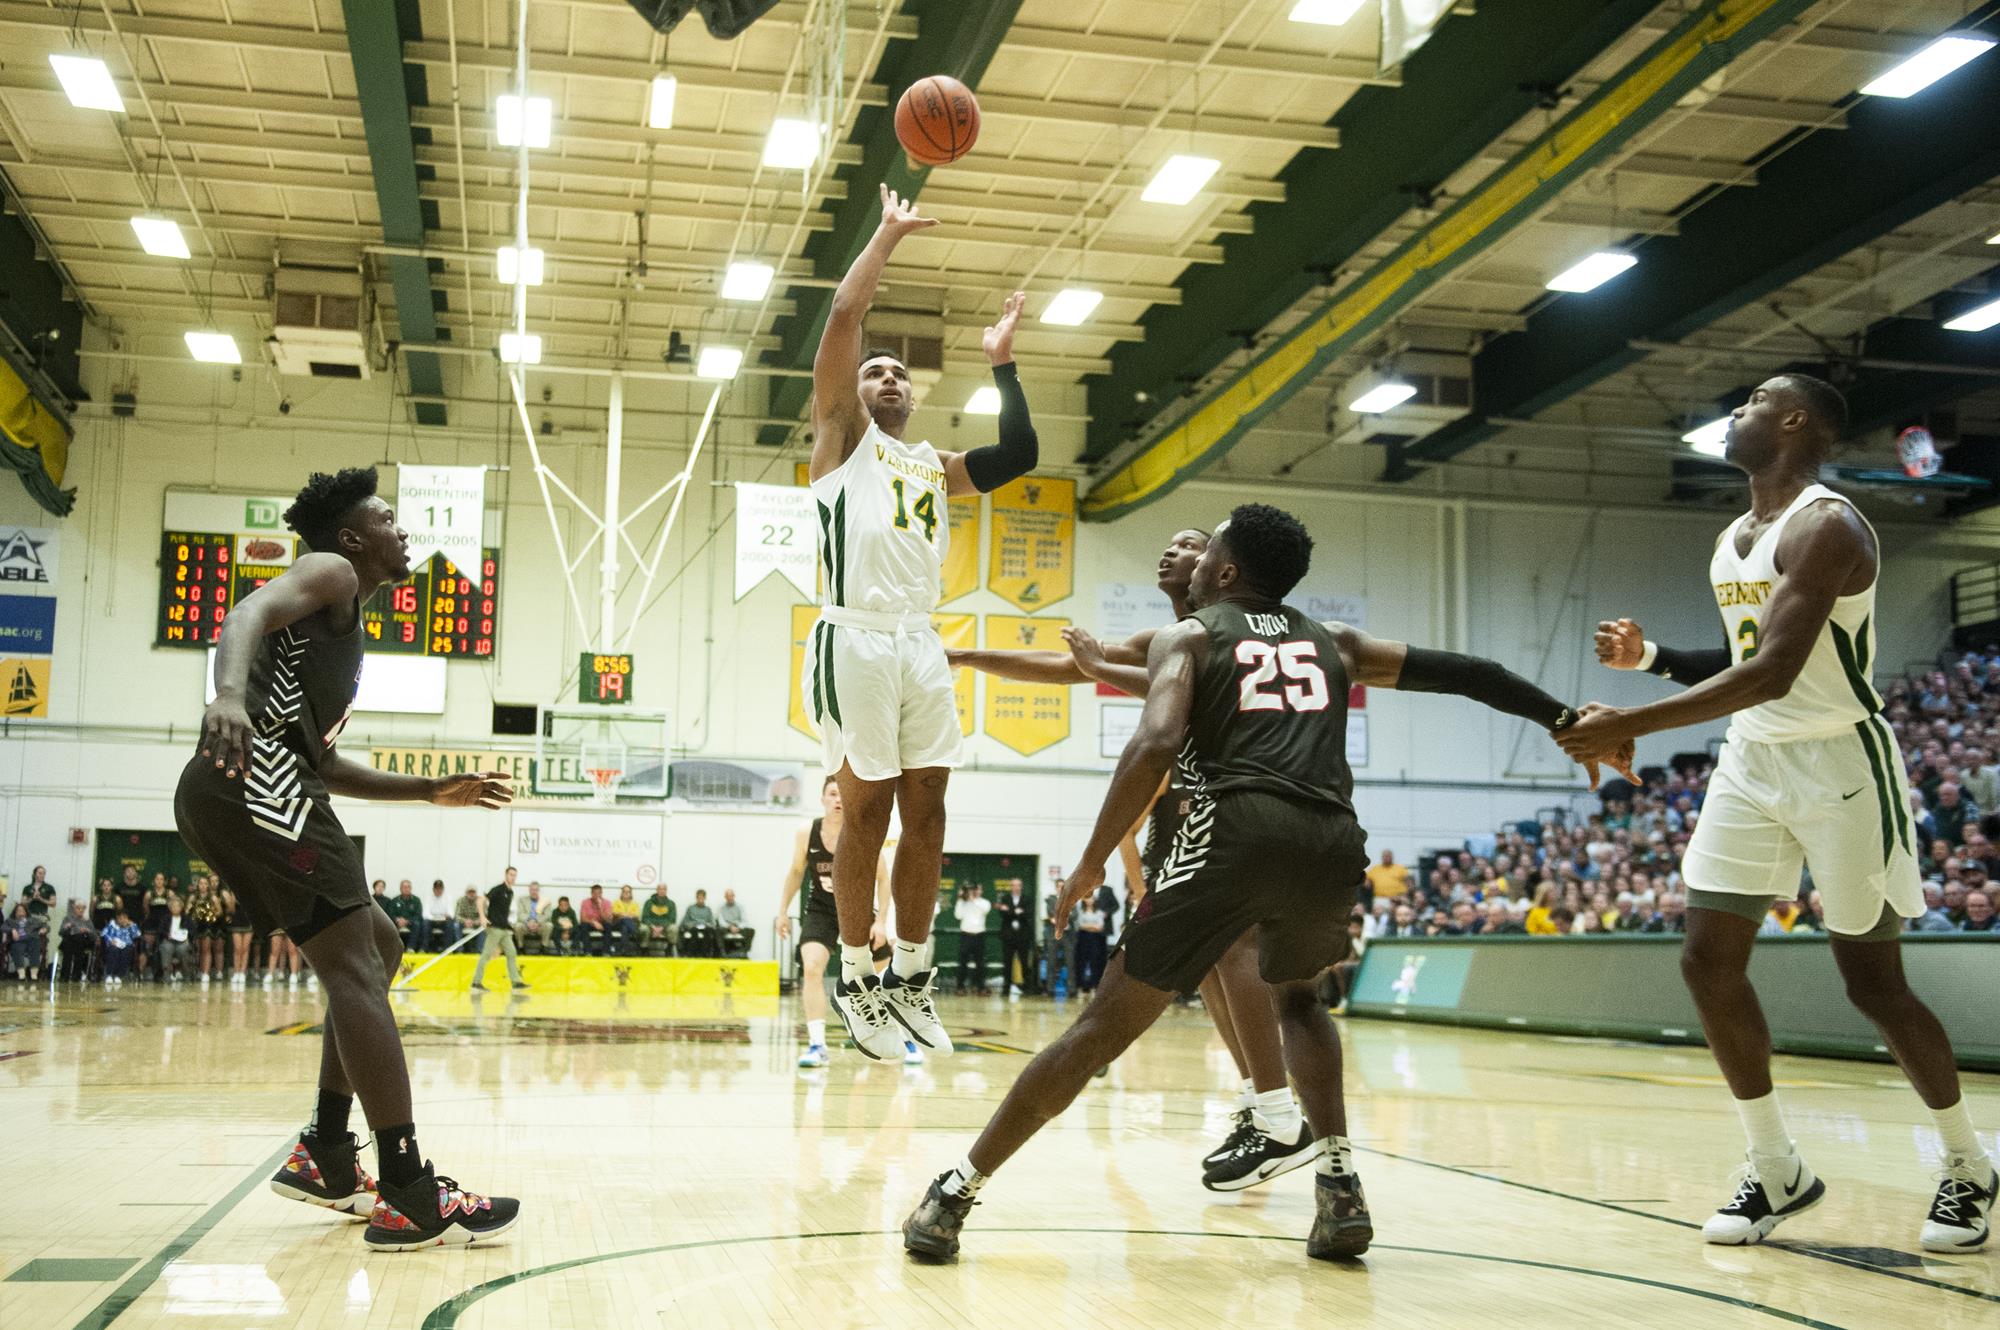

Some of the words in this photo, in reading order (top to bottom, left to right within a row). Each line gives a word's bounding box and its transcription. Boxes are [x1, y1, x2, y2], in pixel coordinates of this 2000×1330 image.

[249, 504, 276, 524] TD
[424, 506, 453, 527] 11
[890, 476, 938, 545] 14
[409, 533, 478, 547] 000-2005
[761, 524, 793, 546] 22
[239, 565, 288, 579] VERMON
[393, 587, 417, 612] 16
[367, 622, 381, 639] 4
[403, 622, 415, 642] 3
[594, 655, 630, 674] 8:56
[599, 673, 624, 699] 19
[1235, 640, 1330, 712] 25
[373, 752, 482, 779] TARRANT
